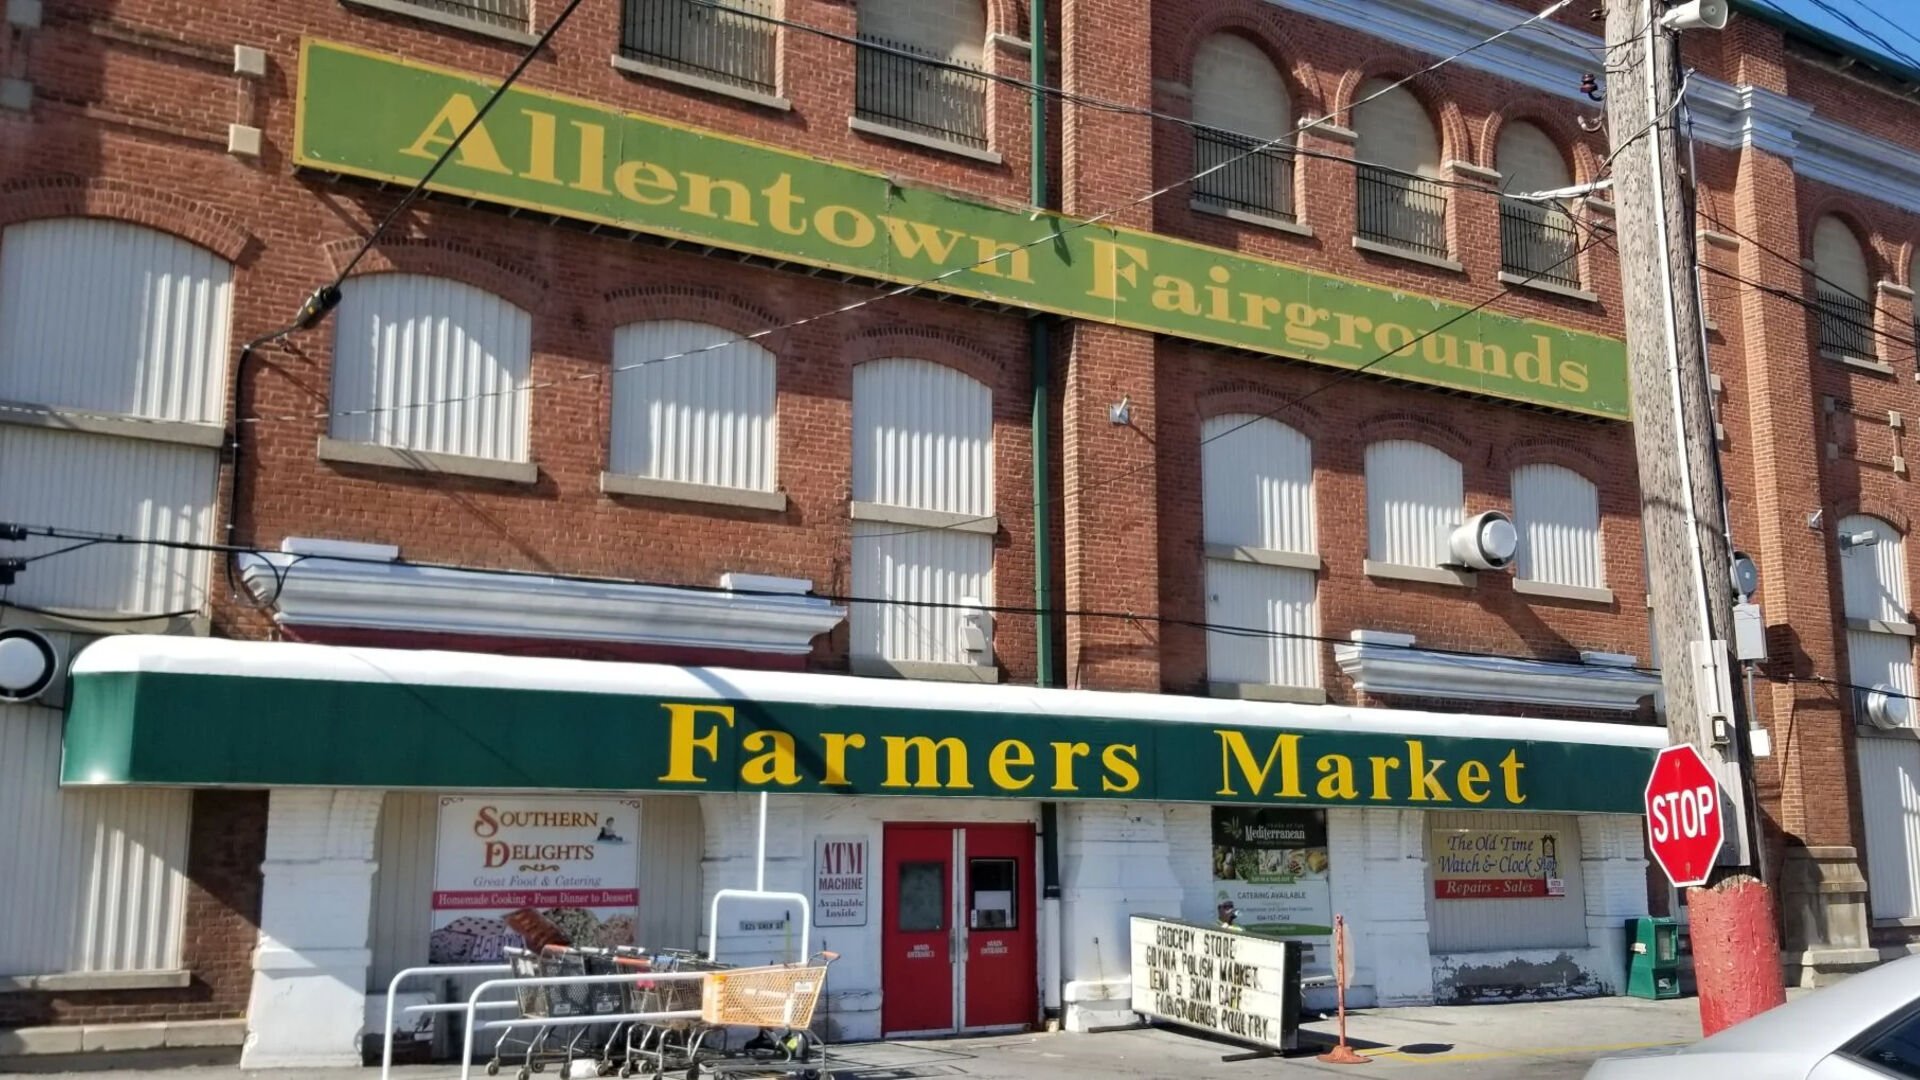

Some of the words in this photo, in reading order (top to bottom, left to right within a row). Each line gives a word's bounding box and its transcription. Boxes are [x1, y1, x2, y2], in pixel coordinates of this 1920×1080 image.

[399, 92, 1036, 284] Allentown
[1085, 237, 1589, 393] Fairgrounds
[658, 703, 1140, 792] Farmers
[1214, 730, 1526, 804] Market
[1653, 786, 1715, 843] STOP
[1244, 824, 1305, 841] Mediterranean
[1448, 834, 1472, 851] The
[1475, 834, 1498, 851] Old
[1501, 836, 1534, 851] Time
[820, 842, 863, 874] ATM
[1438, 853, 1480, 873] Watch
[1483, 854, 1497, 873] &
[1499, 853, 1535, 878] Clock
[473, 876, 505, 887] Great
[509, 875, 537, 887] Food
[541, 876, 550, 886] &
[555, 875, 602, 888] Catering
[819, 877, 863, 890] MACHINE
[1447, 881, 1491, 896] Repairs
[1503, 880, 1534, 894] Sales
[439, 893, 488, 905] Homemade
[491, 892, 526, 905] Cooking
[534, 892, 558, 904] From
[560, 891, 589, 903] Dinner
[591, 892, 600, 902] to
[602, 890, 633, 902] Dessert
[818, 899, 864, 907] Available
[1237, 891, 1270, 900] CATERING
[1271, 891, 1306, 900] AVAILABLE
[826, 908, 857, 918] Inside
[1204, 933, 1236, 959] STORE
[1182, 953, 1214, 979] POLISH
[1220, 960, 1258, 988] MARKET
[1190, 977, 1212, 1003] SKIN
[1221, 1008, 1269, 1041] POULTRY
